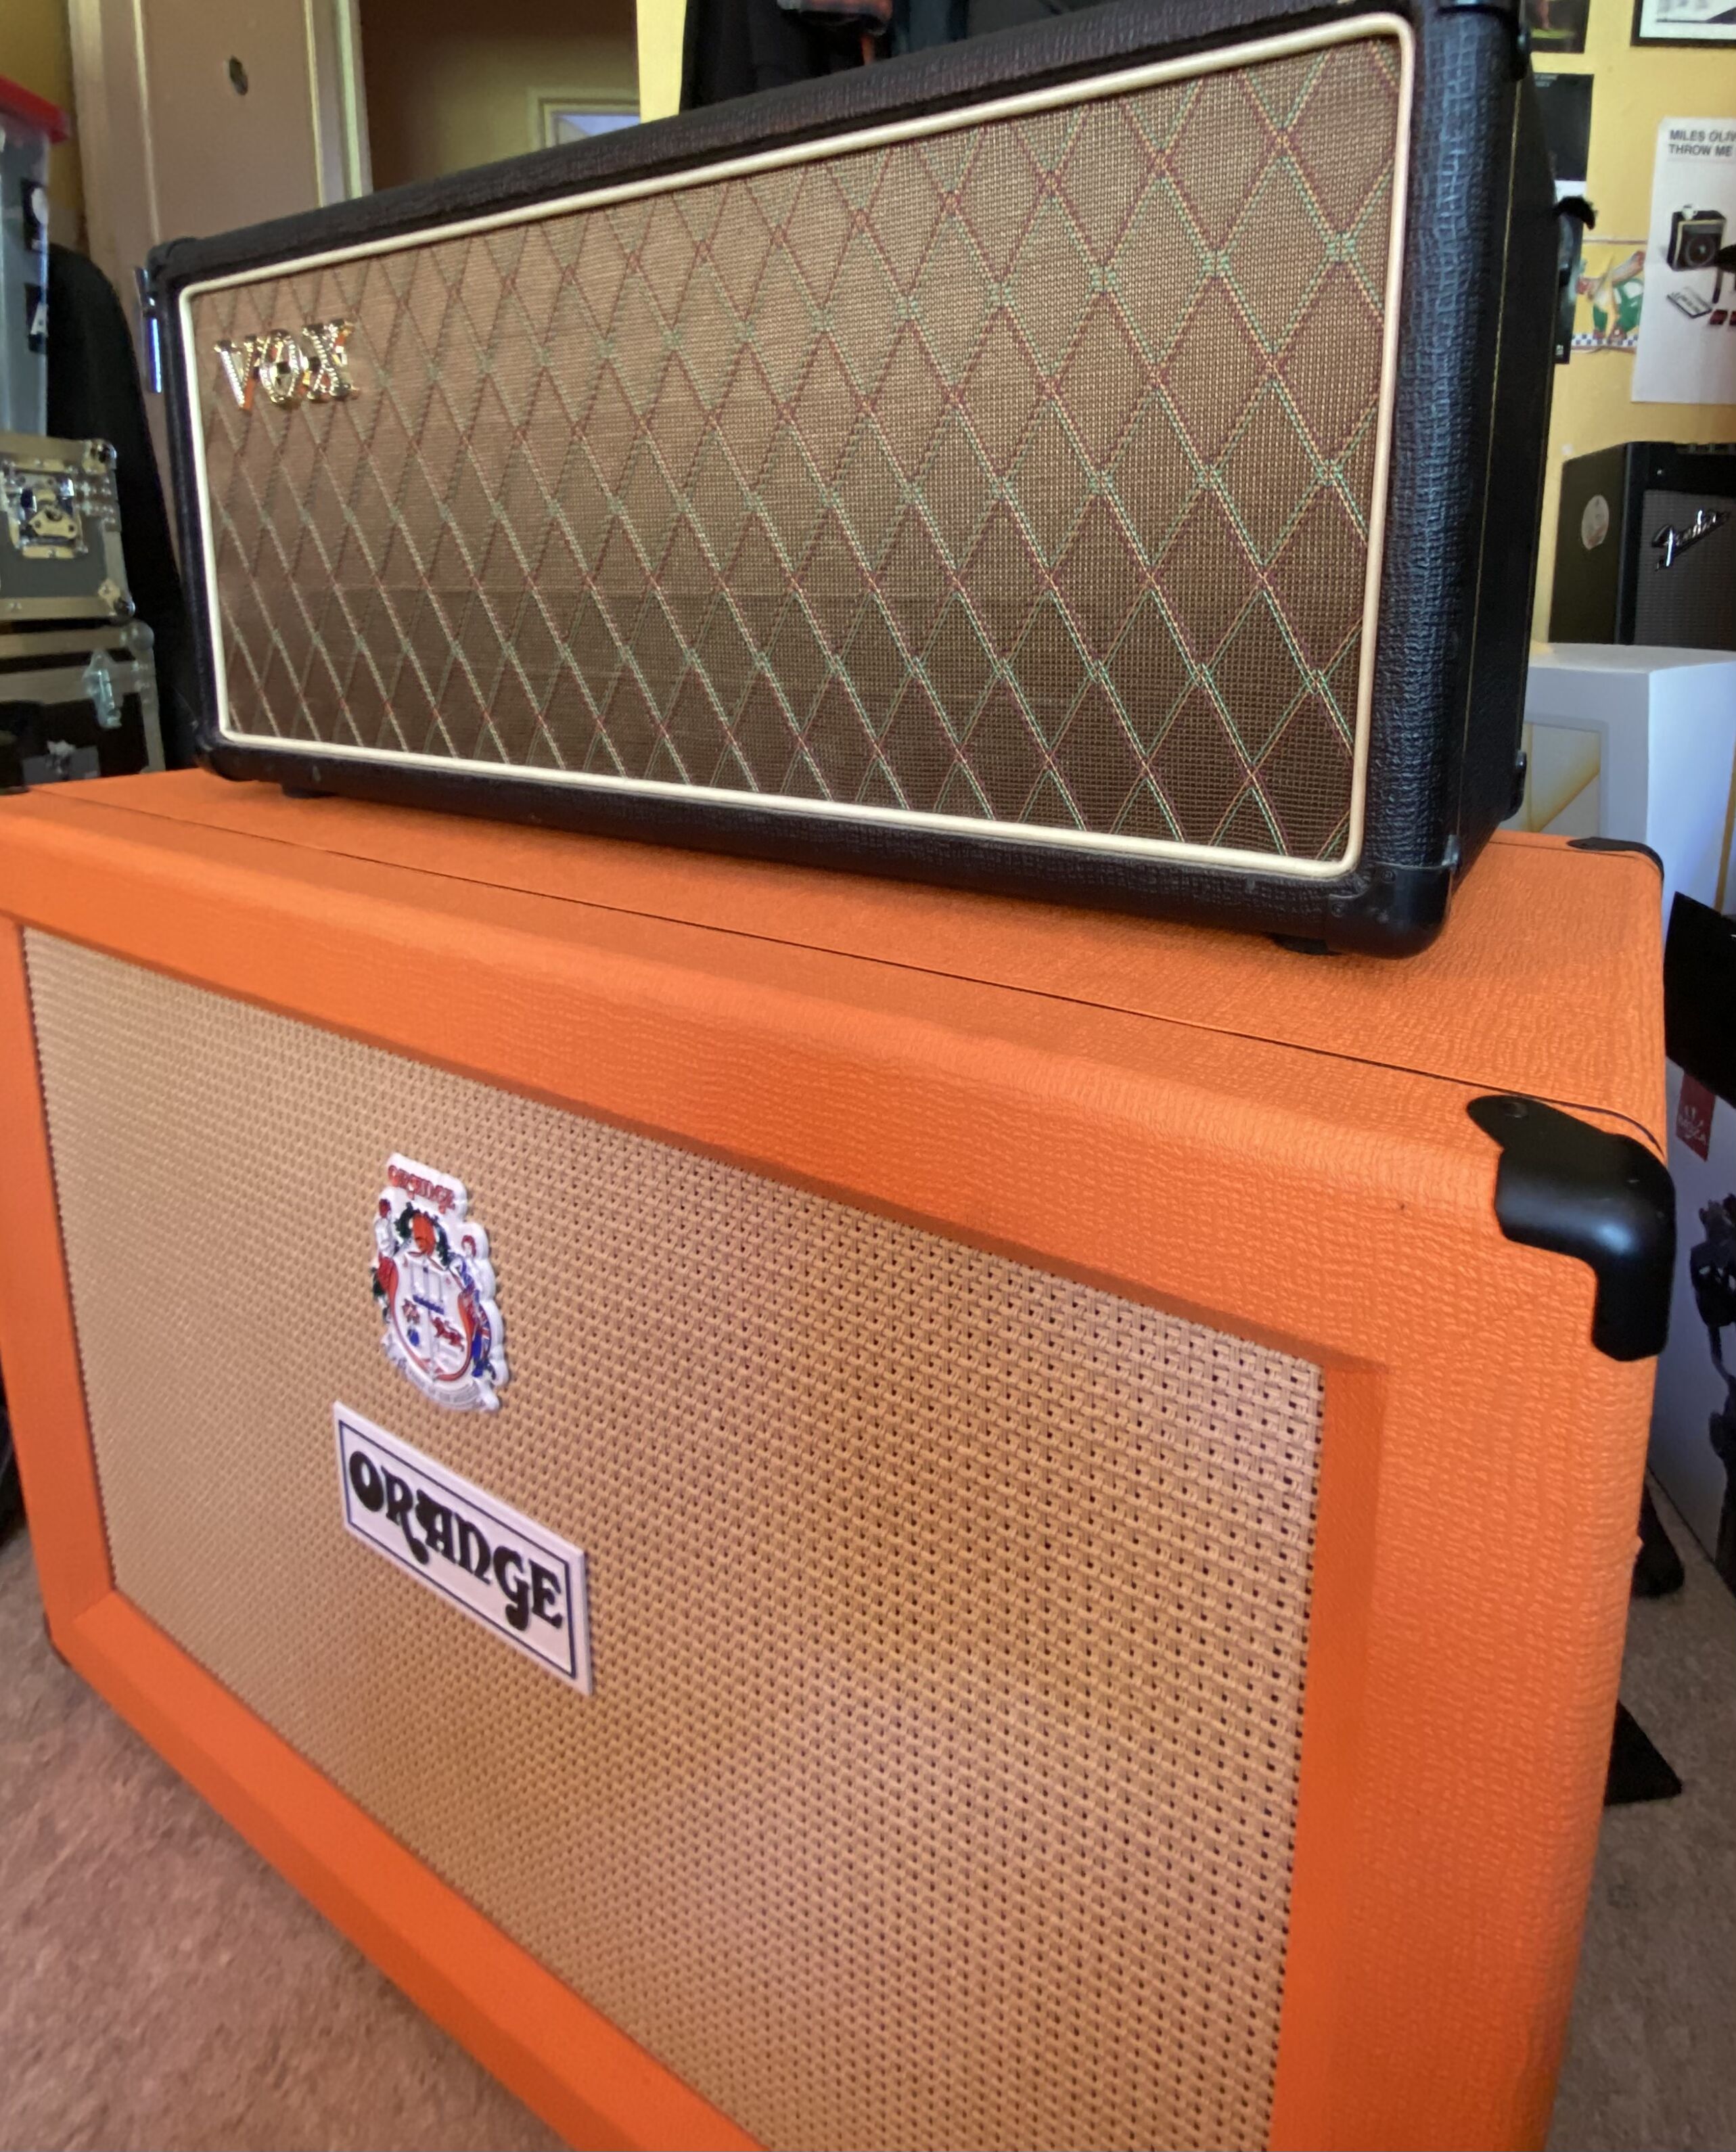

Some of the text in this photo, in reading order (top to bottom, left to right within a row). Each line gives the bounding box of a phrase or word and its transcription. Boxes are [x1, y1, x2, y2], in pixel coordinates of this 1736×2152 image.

[1669, 143, 1733, 156] THROW ME
[1670, 129, 1705, 142] MILES
[214, 318, 357, 410] VOX
[348, 1450, 564, 1632] ORANGE
